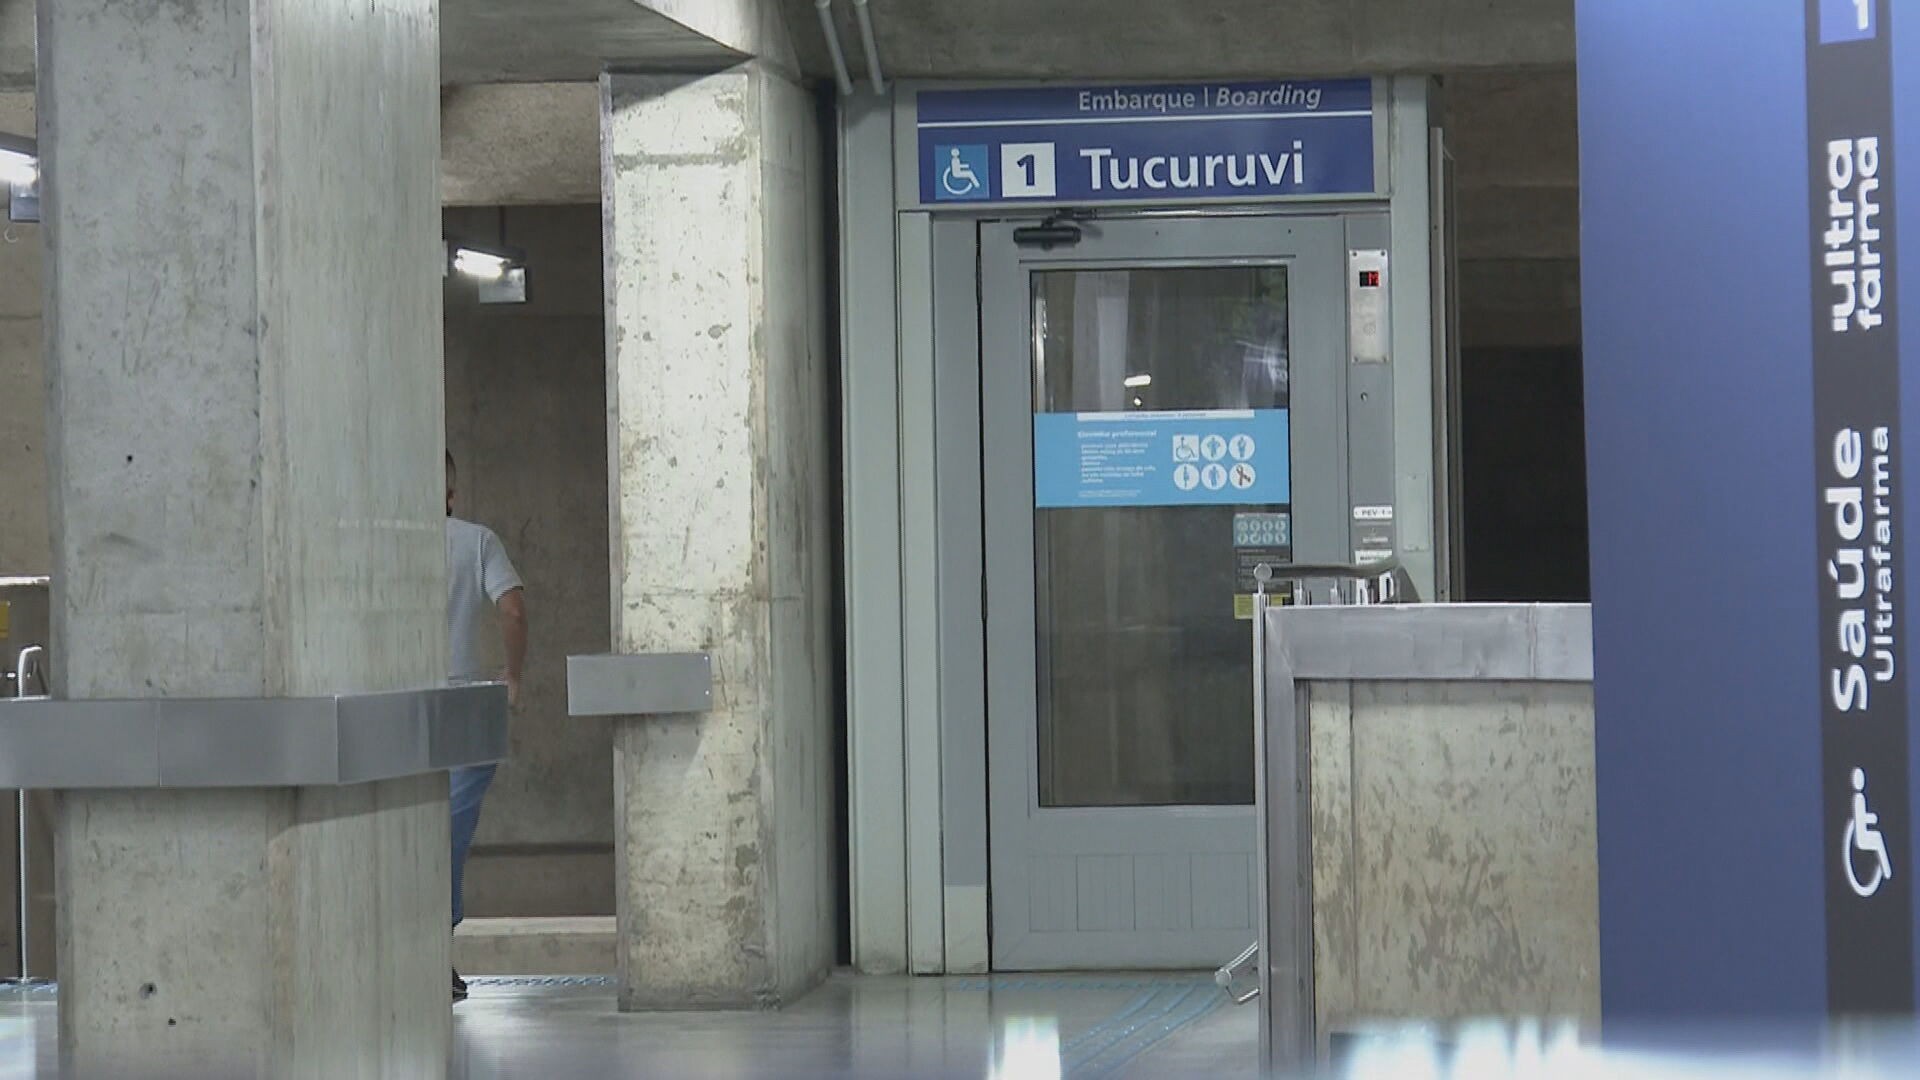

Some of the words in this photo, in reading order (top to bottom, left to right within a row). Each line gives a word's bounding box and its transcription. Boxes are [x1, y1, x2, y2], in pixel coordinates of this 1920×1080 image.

[1015, 153, 1036, 187] 1
[1078, 89, 1196, 113] Embarque
[1215, 85, 1322, 109] Boarding
[1079, 140, 1304, 190] Tucuruvi
[1823, 138, 1856, 318] ultra
[1856, 136, 1882, 330] farma
[1825, 427, 1868, 712] Saúde
[1869, 426, 1895, 682] Ultrafarma
